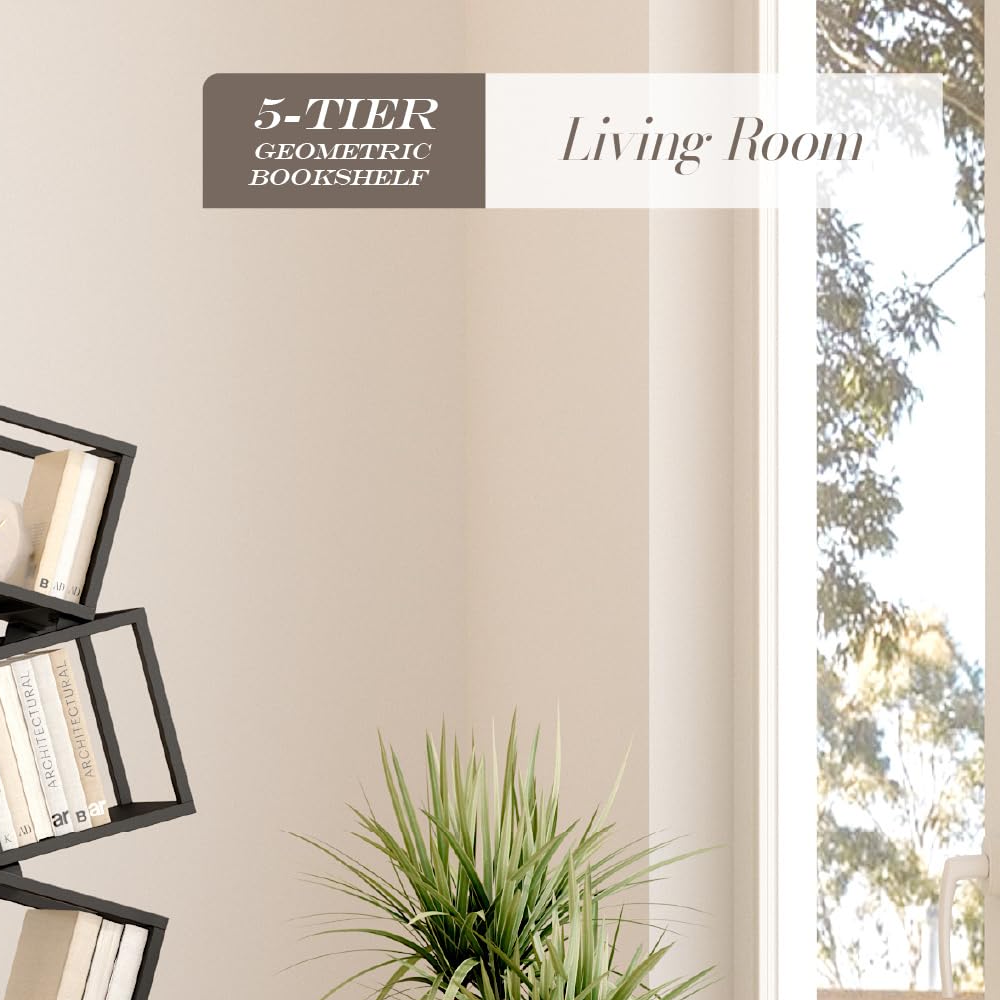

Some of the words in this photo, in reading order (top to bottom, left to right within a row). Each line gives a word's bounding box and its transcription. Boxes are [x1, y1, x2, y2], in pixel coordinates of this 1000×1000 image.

[39, 578, 49, 589] B
[56, 659, 94, 778] ARCHITECTURAL
[25, 671, 58, 788] ARCHITECTURAL
[75, 810, 87, 823] B
[88, 800, 108, 817] ar
[52, 808, 70, 828] ar
